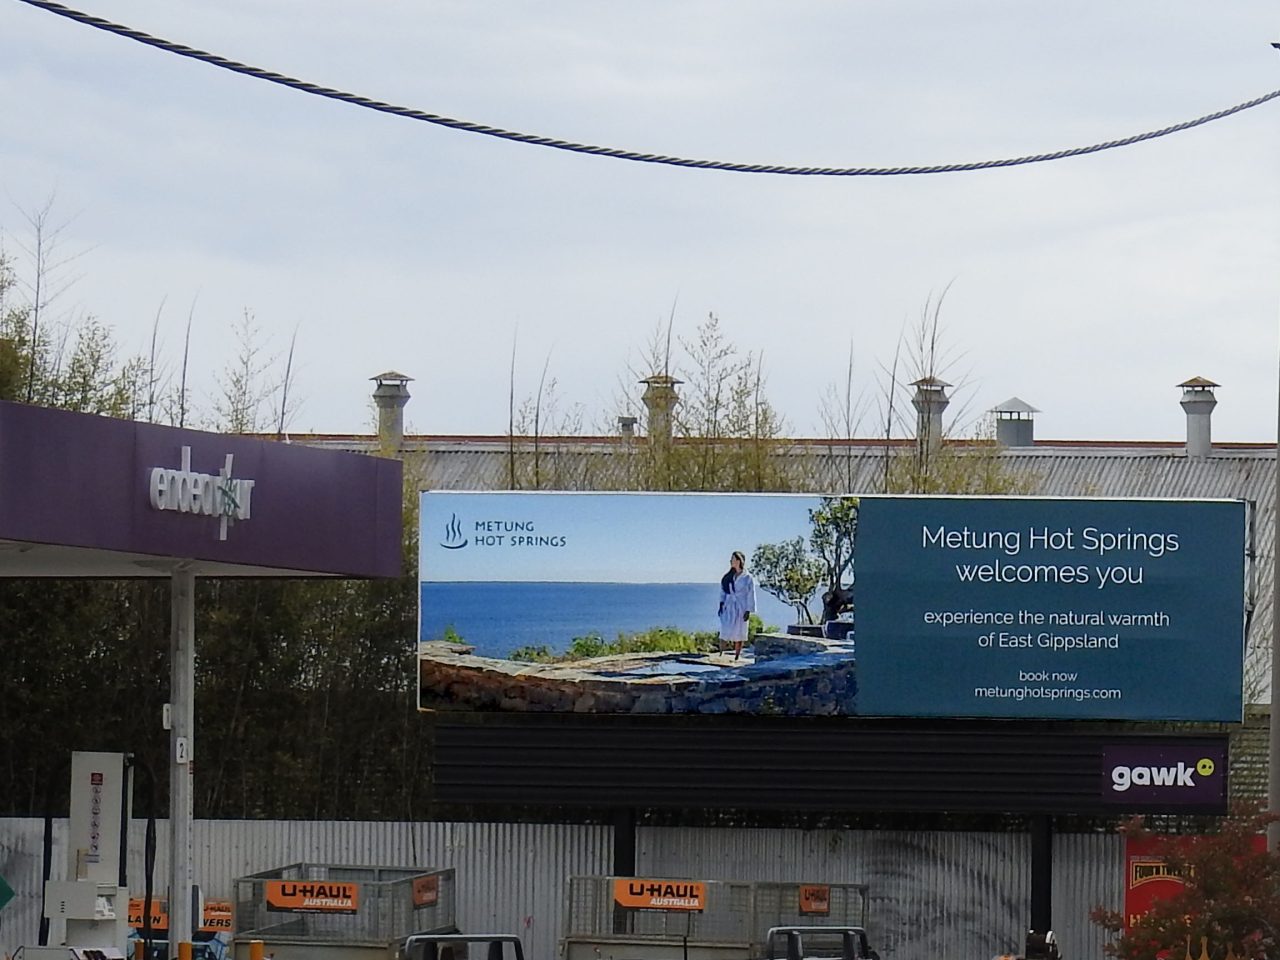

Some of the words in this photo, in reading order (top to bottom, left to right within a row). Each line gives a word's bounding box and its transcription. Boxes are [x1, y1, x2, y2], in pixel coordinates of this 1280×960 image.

[475, 521, 535, 532] METUNG
[475, 536, 505, 546] HOT
[511, 536, 566, 547] SPRINGS
[922, 526, 1021, 555] Metung
[1029, 527, 1075, 551] Hot
[1083, 527, 1180, 557] Springs
[956, 560, 1089, 583] welcomes
[1096, 566, 1144, 589] you
[924, 609, 1014, 627] experience
[1018, 610, 1045, 625] the
[1049, 610, 1105, 626] natural
[1108, 611, 1170, 627] warmth
[978, 632, 995, 648] of
[999, 633, 1033, 648] East
[1037, 633, 1119, 652] Gippsland
[1019, 670, 1049, 682] book
[1052, 671, 1078, 682] now
[974, 686, 1122, 701] metunghotsprings.com
[1111, 762, 1196, 791] gawk
[281, 884, 352, 898] U-HAUL
[629, 883, 699, 899] U-HAUL
[303, 898, 353, 907] AUSTRALIA
[649, 898, 699, 907] AUSTRALIA
[128, 914, 162, 924] LAN
